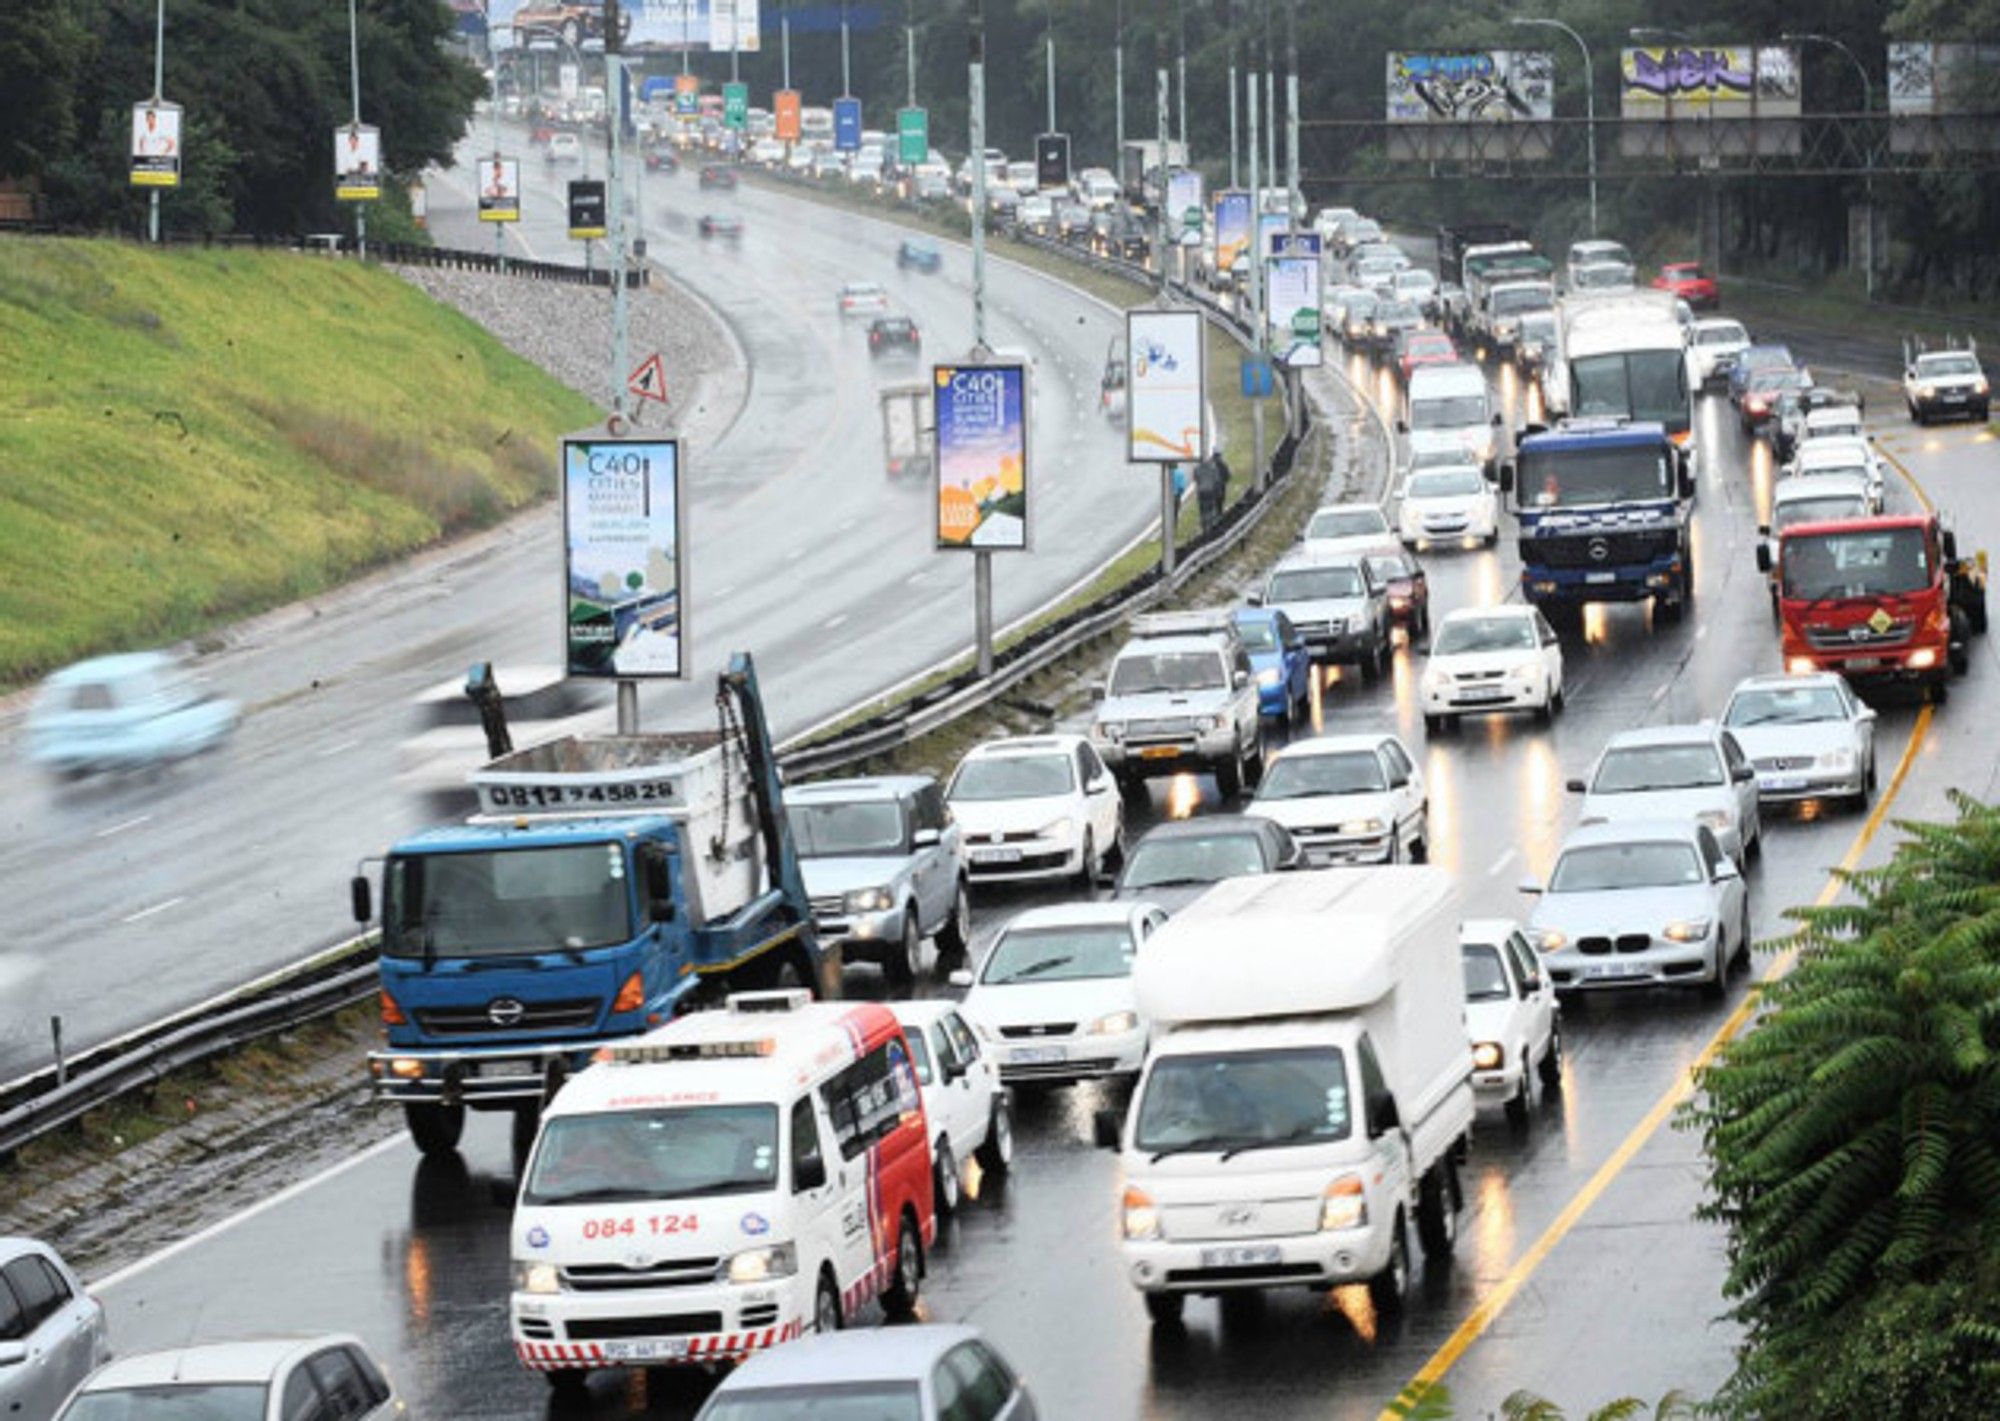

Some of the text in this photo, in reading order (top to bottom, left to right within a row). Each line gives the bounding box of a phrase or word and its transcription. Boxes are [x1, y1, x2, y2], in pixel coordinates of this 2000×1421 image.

[953, 373, 995, 393] C40
[588, 452, 641, 476] C40
[582, 1214, 699, 1239] 084 124
